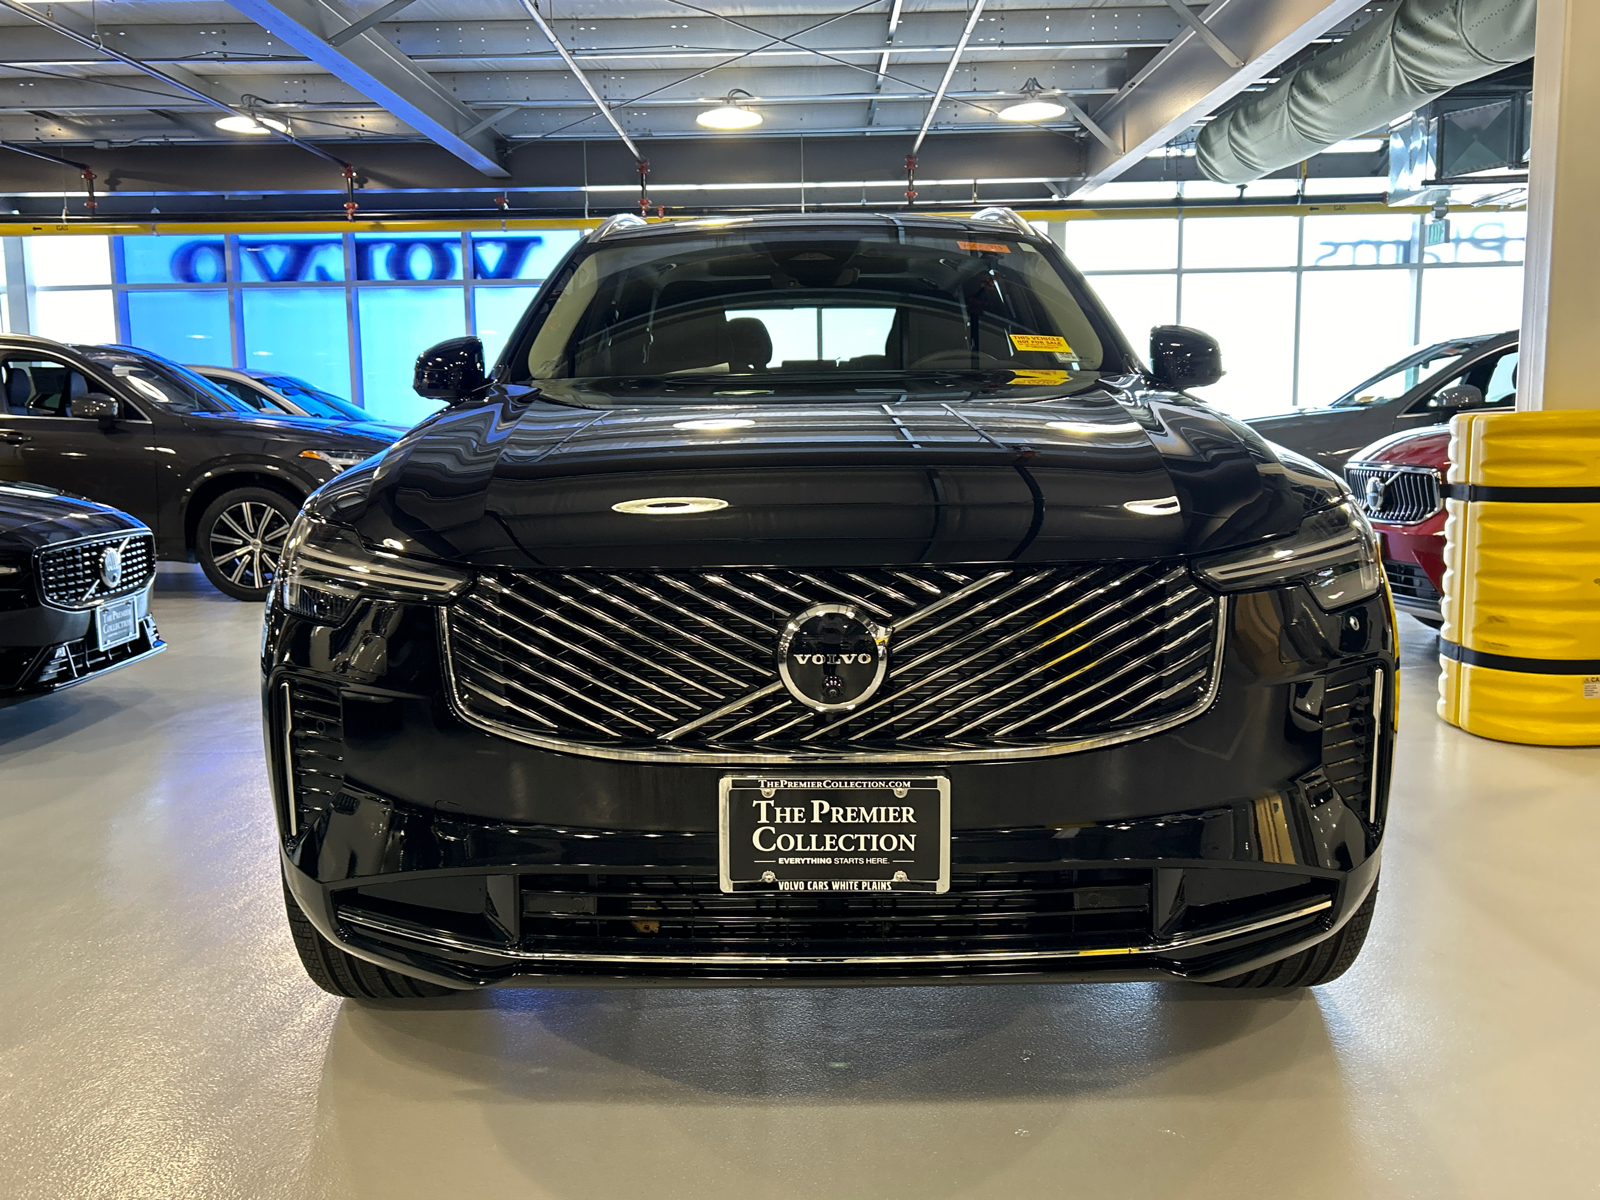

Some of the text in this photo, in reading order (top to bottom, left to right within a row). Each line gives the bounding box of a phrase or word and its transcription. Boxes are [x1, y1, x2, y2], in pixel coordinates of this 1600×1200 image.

[793, 653, 872, 665] VOLVO
[752, 800, 917, 823] THE PREMIER
[752, 826, 917, 852] COLLECTION
[778, 857, 890, 865] EVERYTHING STARTS HERE.
[778, 881, 892, 891] VOLVO CARS WHITE PLAINS
